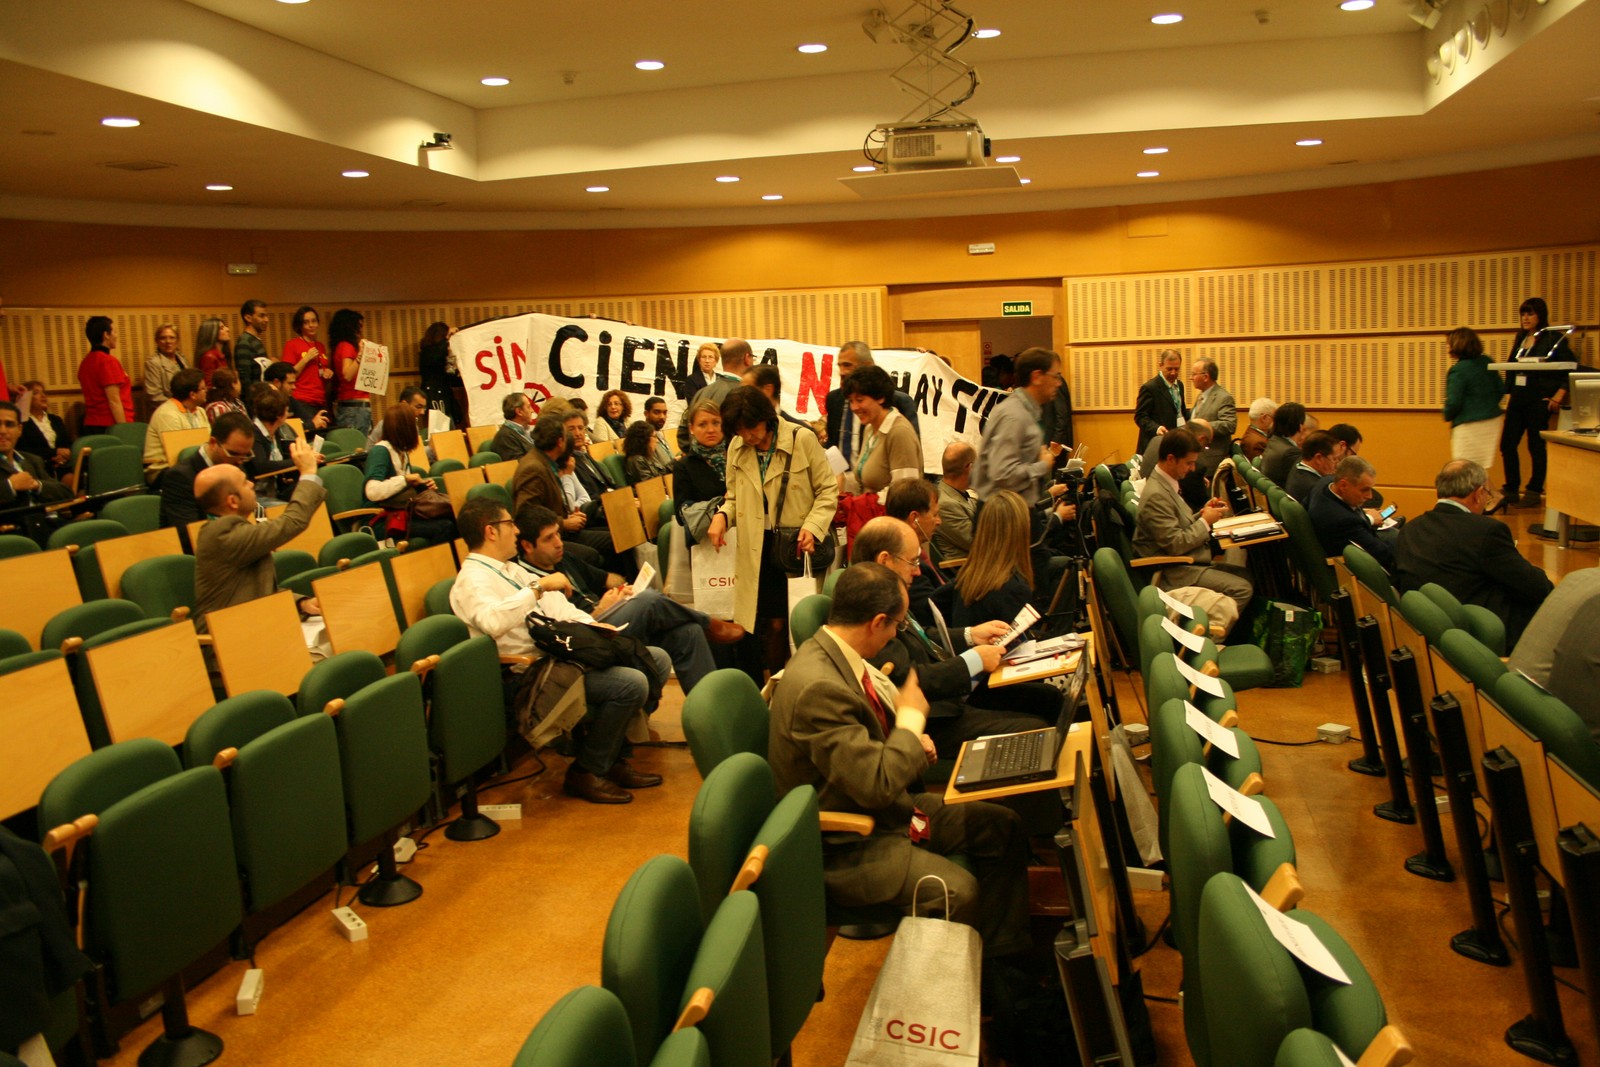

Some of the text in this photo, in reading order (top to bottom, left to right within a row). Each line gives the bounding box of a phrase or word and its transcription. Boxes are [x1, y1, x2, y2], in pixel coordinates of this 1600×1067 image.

[1004, 305, 1030, 313] SALIDA
[795, 351, 834, 416] N
[886, 1019, 961, 1050] CSIC
